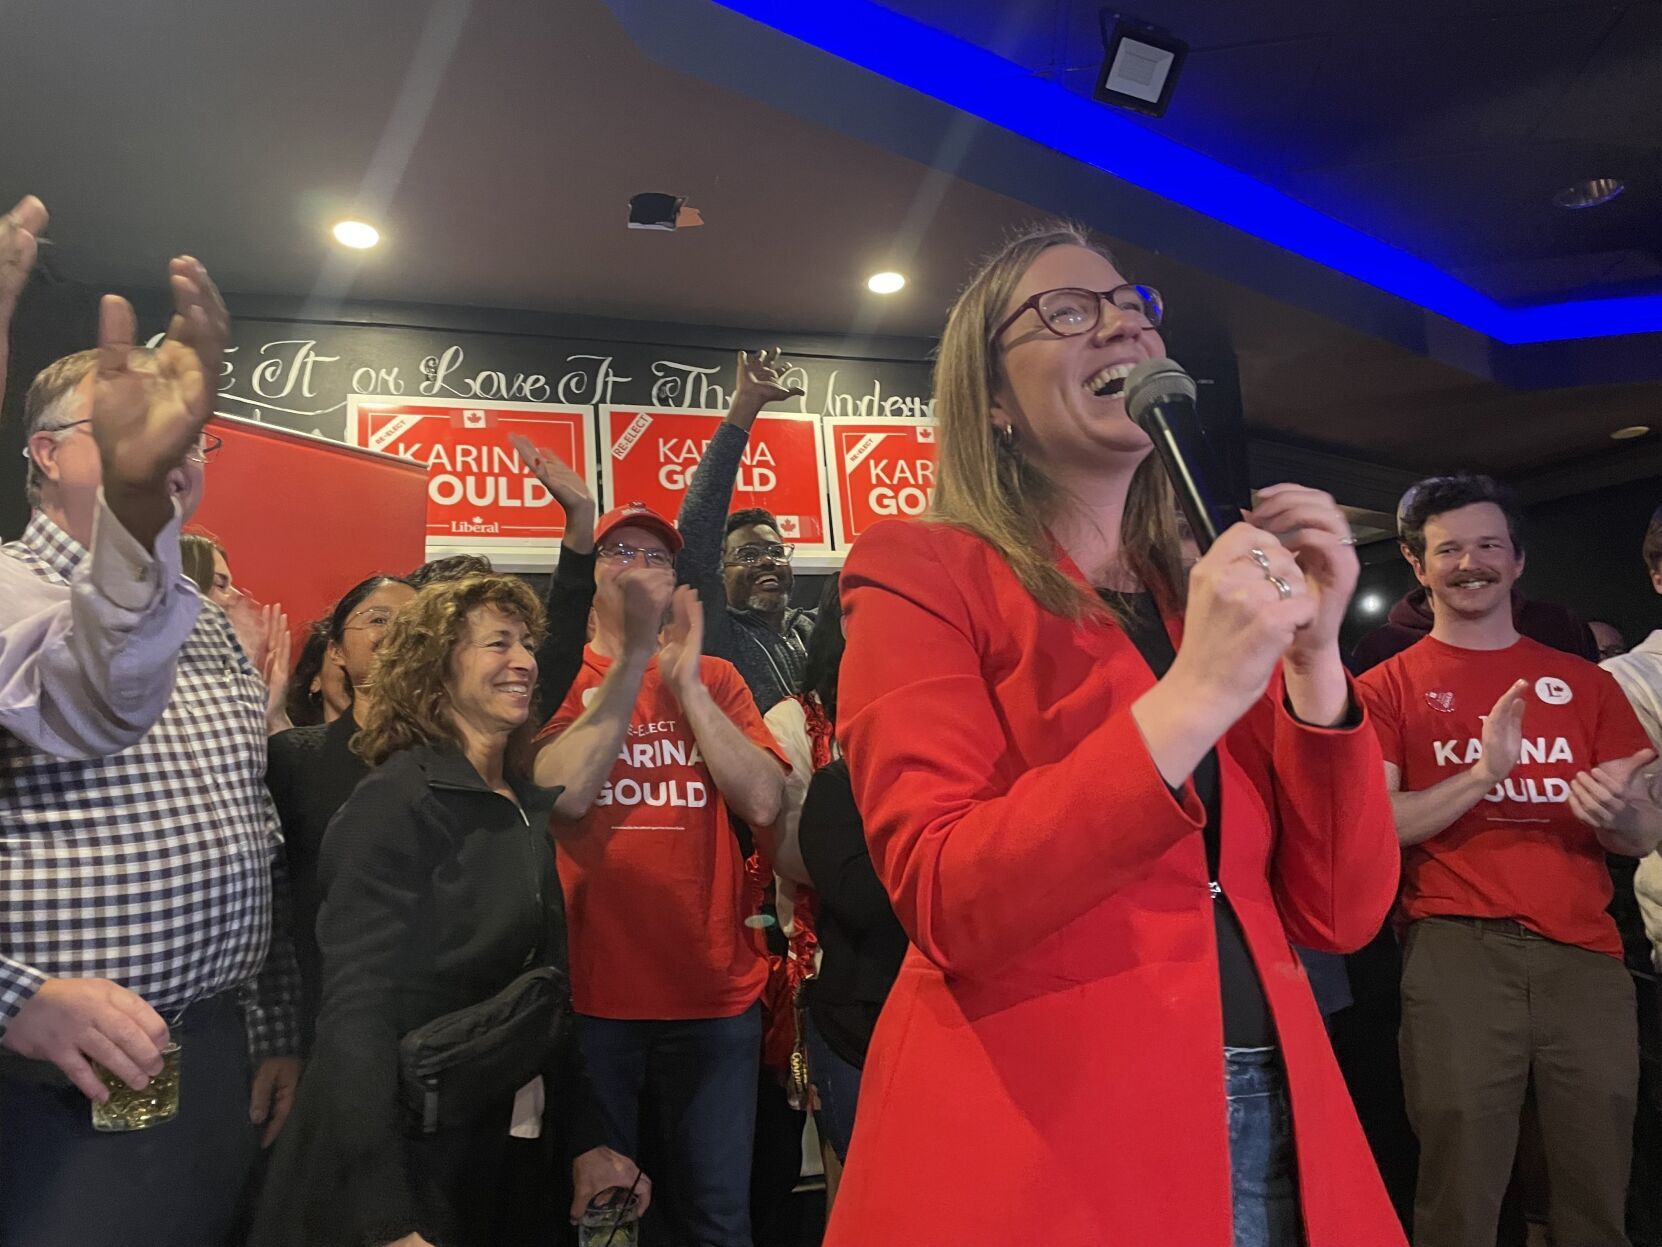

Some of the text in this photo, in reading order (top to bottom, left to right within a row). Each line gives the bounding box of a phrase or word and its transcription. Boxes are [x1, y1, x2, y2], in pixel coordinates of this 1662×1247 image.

[252, 340, 340, 398] It
[352, 367, 405, 394] or
[419, 345, 550, 401] Love
[558, 354, 632, 405] It
[398, 442, 531, 474] KARIN
[659, 438, 776, 466] KANA
[658, 464, 776, 492] GLD
[868, 459, 935, 484] KAR
[428, 474, 552, 507] OULD
[451, 518, 499, 533] Liberal
[1433, 737, 1573, 766] KANA
[1483, 778, 1571, 803] OULD
